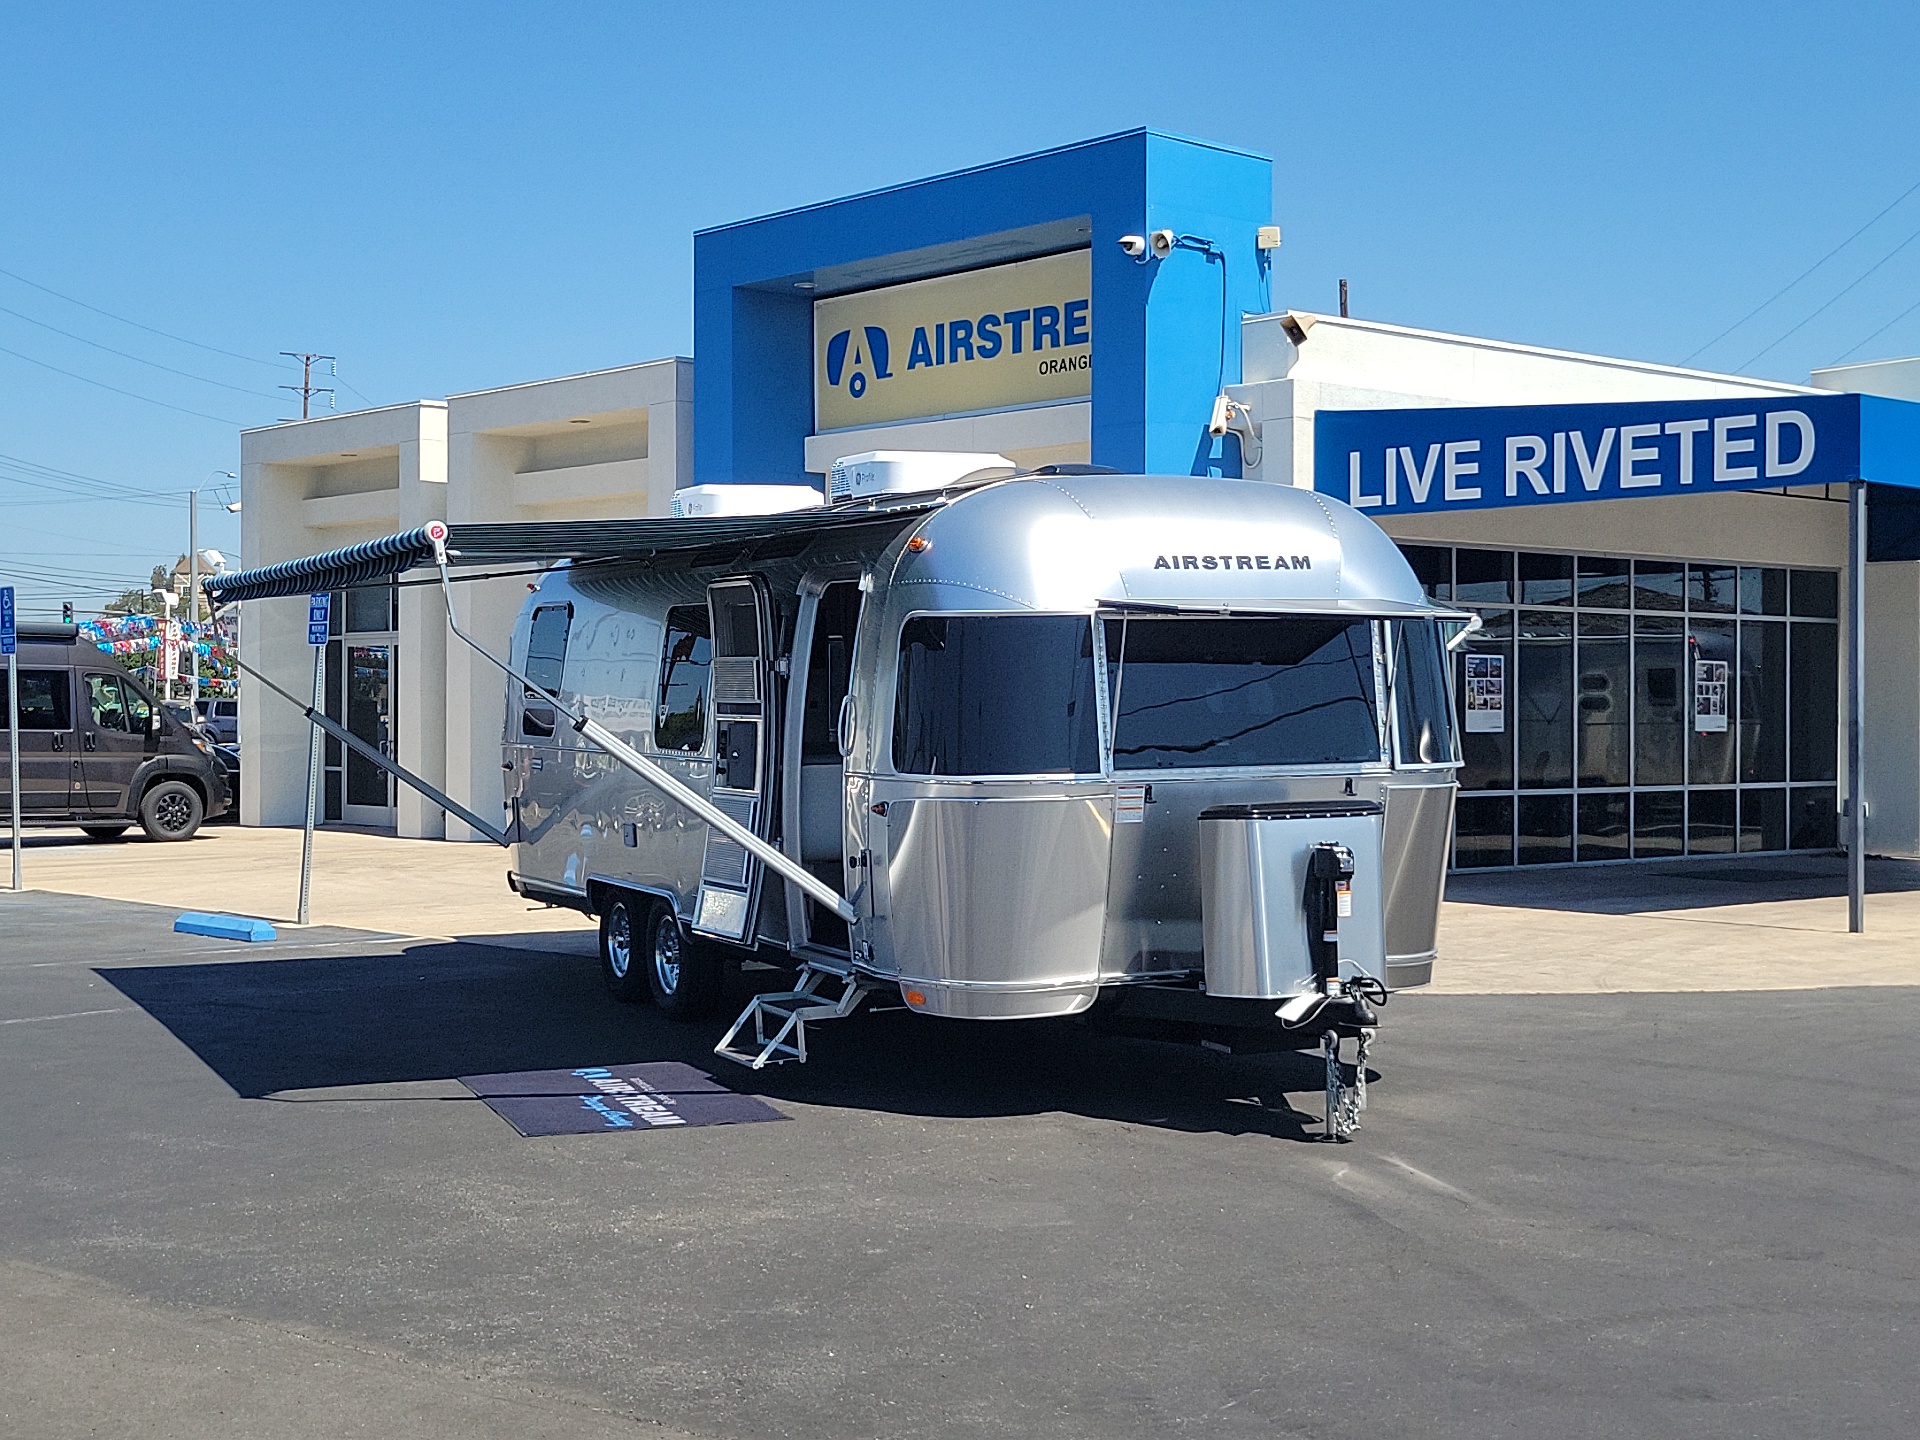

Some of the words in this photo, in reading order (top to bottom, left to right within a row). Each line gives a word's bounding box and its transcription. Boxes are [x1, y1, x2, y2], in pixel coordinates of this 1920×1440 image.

[907, 299, 1091, 370] AIRSTRE
[1039, 354, 1092, 375] ORANG
[1349, 440, 1482, 508] LIVE
[1505, 410, 1816, 497] RIVETED
[1153, 555, 1312, 570] AIRSTREAM
